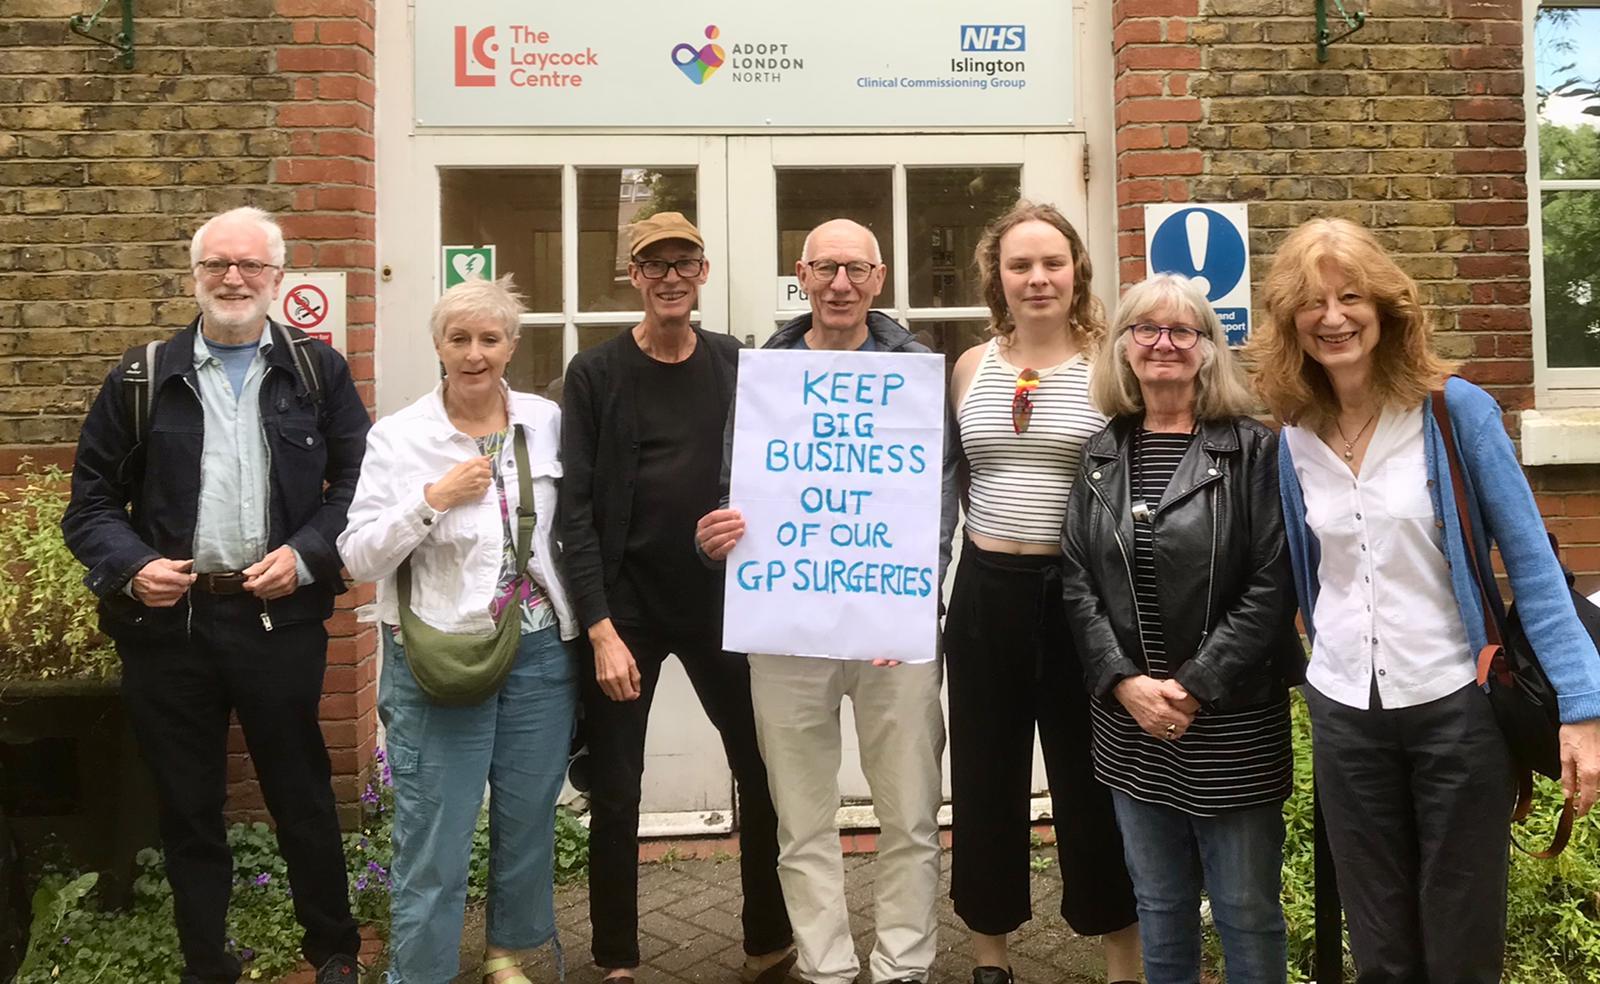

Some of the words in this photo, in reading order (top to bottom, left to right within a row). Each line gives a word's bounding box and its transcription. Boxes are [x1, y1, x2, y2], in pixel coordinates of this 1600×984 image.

[510, 25, 549, 44] The
[962, 26, 1023, 50] NHS
[510, 47, 598, 71] Laycock
[732, 43, 788, 55] ADOPT
[732, 58, 803, 70] LONDON
[951, 57, 1025, 76] Islington
[510, 68, 582, 88] Centre
[732, 72, 781, 83] NORTH
[857, 77, 898, 88] Clinical
[900, 77, 988, 90] Commissioning
[990, 77, 1026, 90] Group
[803, 370, 905, 406] KEEP
[812, 412, 874, 438] BIG
[766, 439, 926, 474] BUSINESS
[799, 486, 872, 515] OUT
[776, 521, 821, 548] OF
[830, 522, 893, 548] OUR
[736, 559, 786, 592] GP
[792, 558, 933, 598] SURGERIES
